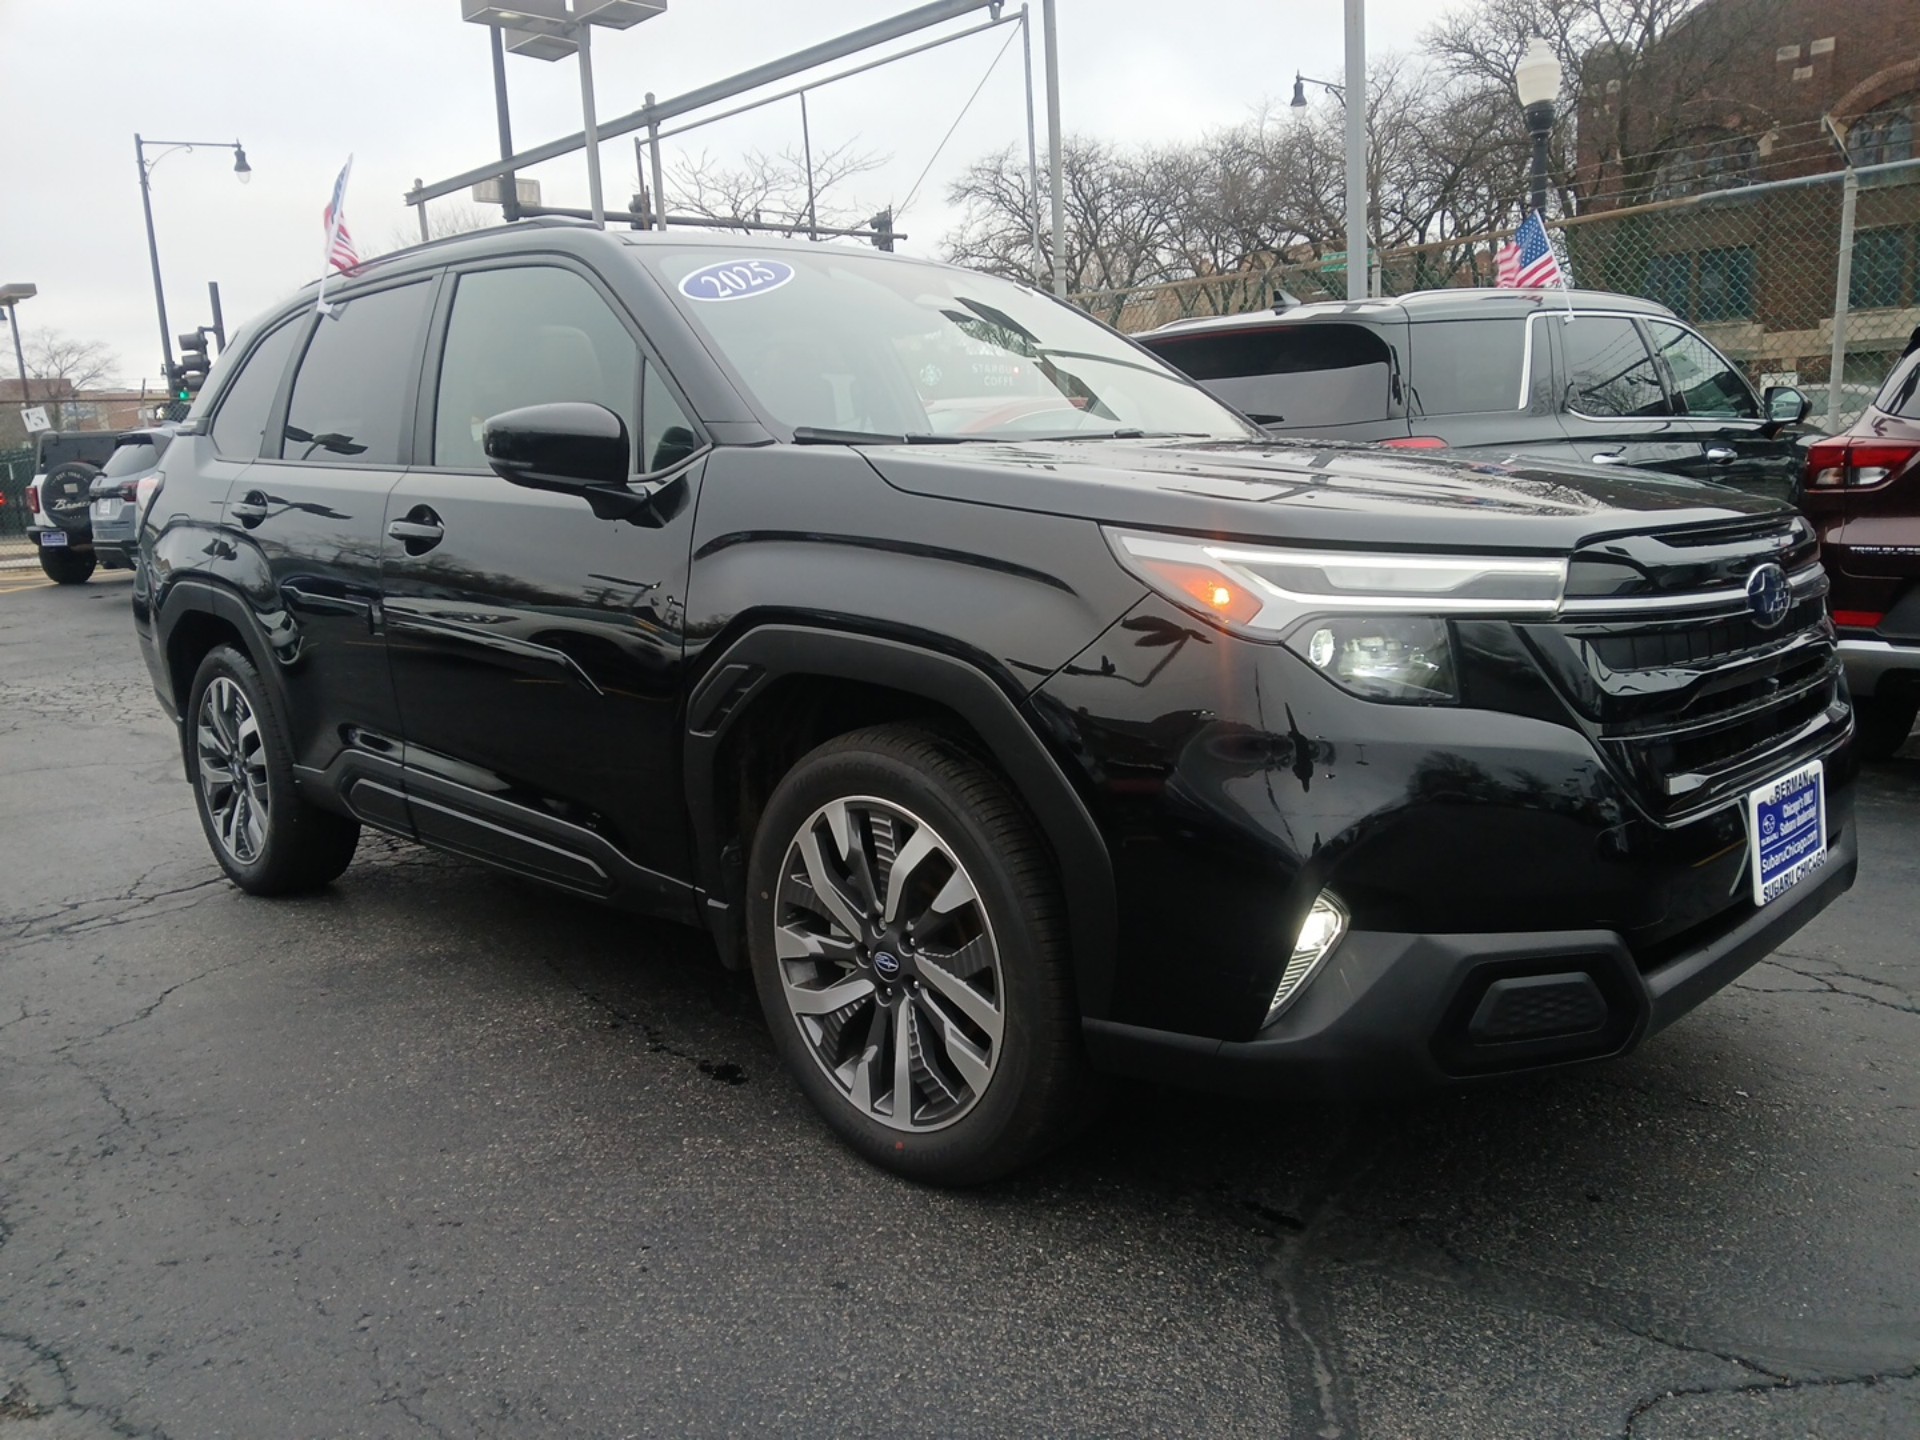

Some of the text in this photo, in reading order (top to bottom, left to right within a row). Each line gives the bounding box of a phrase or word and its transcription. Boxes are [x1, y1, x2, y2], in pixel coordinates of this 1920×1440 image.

[701, 261, 775, 297] 2025
[971, 362, 1035, 375] STARBUS
[1774, 770, 1809, 801] BERMAN
[1761, 829, 1818, 873] SubaruChicago.com
[1763, 848, 1826, 903] SUBARU CHICAGO
